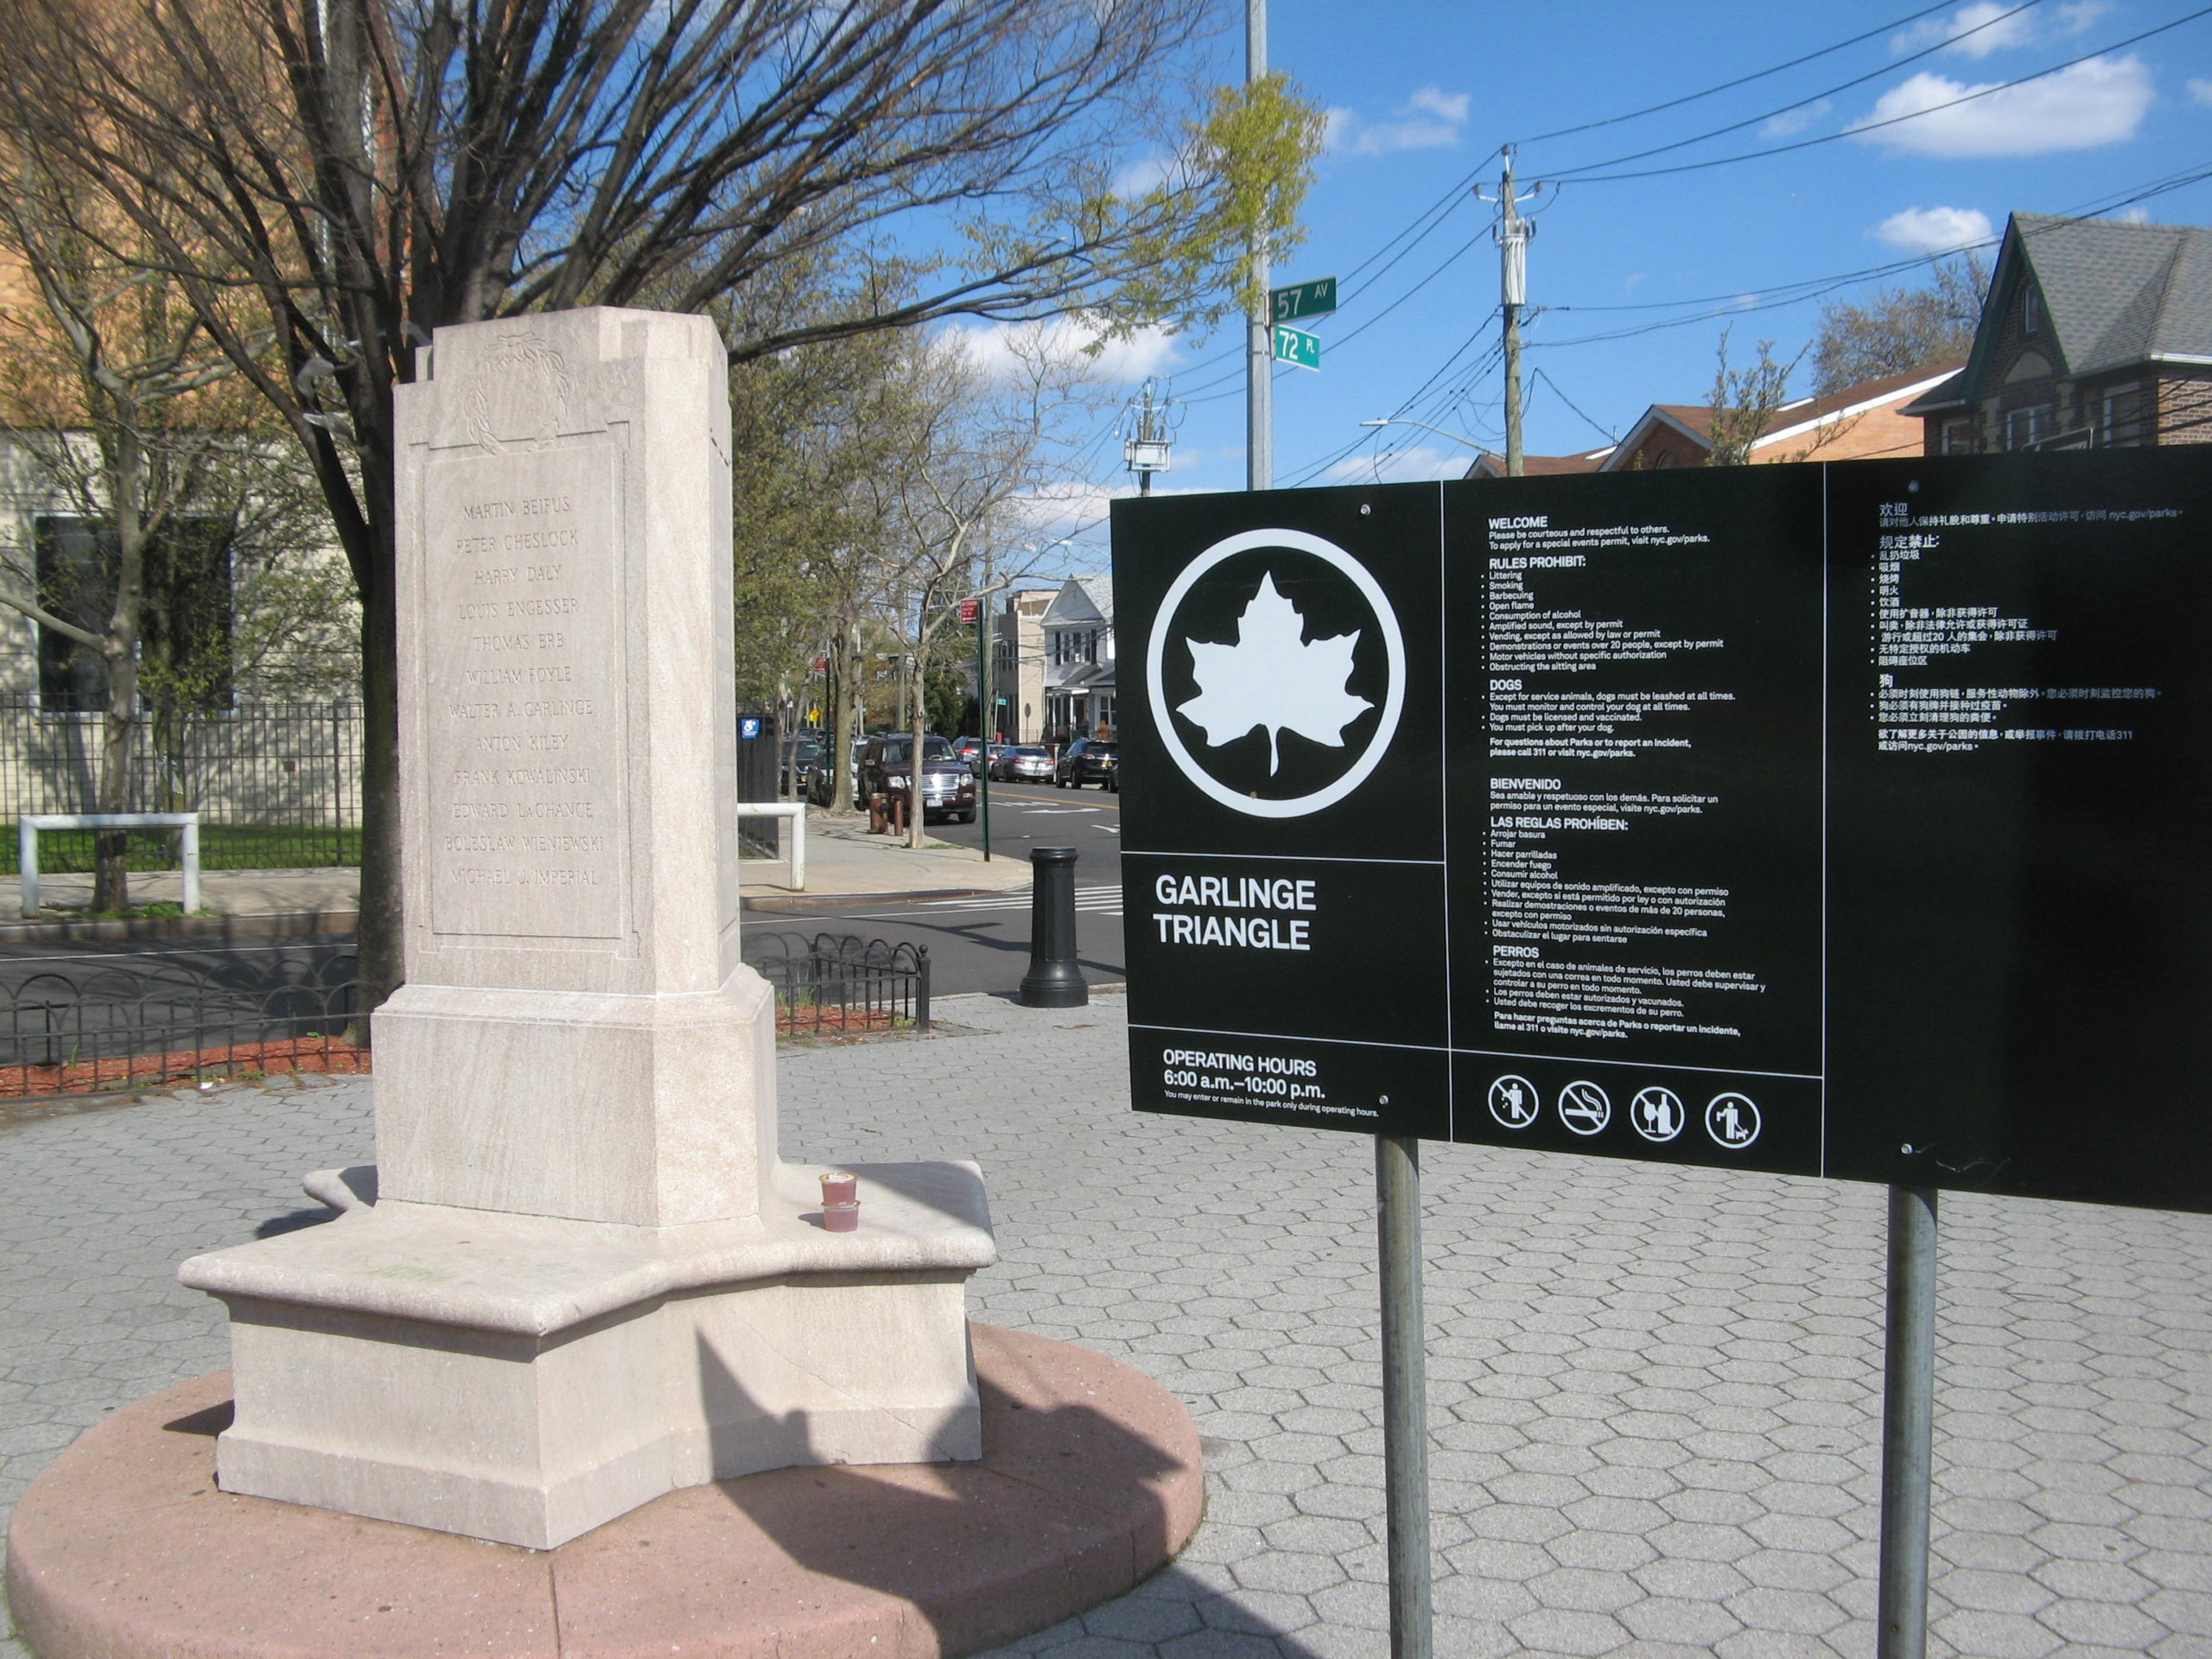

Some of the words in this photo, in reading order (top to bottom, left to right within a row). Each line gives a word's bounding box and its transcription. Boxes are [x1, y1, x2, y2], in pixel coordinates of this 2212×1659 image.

[1279, 289, 1302, 318] 57
[1315, 283, 1327, 298] AV
[1280, 330, 1298, 359] 72
[1306, 339, 1314, 353] PL
[463, 501, 514, 520] MARTIN
[522, 496, 570, 516] BEIFUS
[1878, 503, 1908, 517] 欢迎
[1488, 517, 1548, 530] WELCOME
[1488, 531, 1515, 540] Please
[1516, 531, 1527, 539] be
[1528, 529, 1568, 538] courteous
[1569, 528, 1585, 537] and
[1586, 526, 1629, 538] respectful
[1640, 525, 1669, 534] others.
[456, 537, 496, 554] PETER
[503, 529, 579, 551] CHESLOCK
[1489, 541, 1498, 550] To
[1499, 541, 1521, 551] apply
[1522, 540, 1534, 549] for
[1541, 539, 1570, 550] special
[1571, 537, 1599, 547] events
[1600, 537, 1630, 548] permit,
[1630, 536, 1649, 544] visit
[1649, 534, 1710, 546] nyc.gov/parks.
[1489, 556, 1527, 569] RULES
[1529, 555, 1586, 568] PROHIBIT:
[1878, 562, 1900, 572] 吸烟
[474, 567, 518, 586] HARRY
[527, 564, 562, 582] DALY
[1489, 570, 1522, 582] Littering
[1489, 581, 1523, 592] Smoking
[1878, 585, 1899, 596] 明火
[1489, 591, 1534, 602] Barbecuing
[1878, 597, 1899, 607] 饮酒
[459, 602, 498, 620] LOUIS
[508, 598, 579, 617] ENGESSER
[1489, 601, 1510, 612] Open
[1510, 601, 1535, 609] flame
[1489, 611, 1541, 622] Consumption
[1551, 610, 1581, 619] alcohol
[1489, 621, 1526, 632] Amplified
[1528, 620, 1554, 630] sound,
[1555, 620, 1583, 631] except
[1584, 620, 1594, 630] by
[1595, 620, 1623, 630] permit
[474, 634, 530, 652] THOMAS
[539, 632, 564, 649] ERB
[1489, 632, 1522, 642] Vending,
[1523, 631, 1550, 642] except
[1562, 631, 1593, 639] allowed
[1595, 631, 1605, 640] by
[1606, 630, 1621, 639] law
[1633, 629, 1661, 640] permit
[1514, 652, 1546, 660] vehicles
[1547, 652, 1578, 660] without
[1579, 652, 1611, 662] specific
[1612, 651, 1667, 659] authorization
[1490, 662, 1535, 672] Obstructing
[1536, 662, 1550, 671] the
[1551, 662, 1577, 672] sitting
[467, 668, 522, 684] WILLIAM
[529, 667, 572, 683] FOYLE
[1878, 674, 1894, 688] 狗
[1490, 679, 1522, 690] DOGS
[449, 703, 499, 719] WALTER
[524, 700, 593, 717] GARLINGE
[1490, 713, 1509, 722] Dogs
[1526, 723, 1543, 734] pick
[1544, 725, 1555, 734] up
[1577, 725, 1595, 734] your
[1597, 723, 1614, 734] dog.
[475, 735, 520, 752] ANTON
[530, 734, 569, 752] KILEY
[1490, 748, 1516, 758] please
[1576, 748, 1636, 759] nyc.gov/parks.
[454, 769, 499, 785] FRANK
[506, 767, 591, 785] KOWALINSKI
[1490, 779, 1561, 790] BIENVENIDO
[453, 803, 507, 818] EDWARD
[1491, 816, 1513, 828] LAS
[1515, 817, 1561, 829] REGLAS
[1563, 815, 1629, 830] PROHÍBEN:
[1491, 830, 1517, 840] Arrojar
[1518, 830, 1546, 838] basura
[444, 836, 514, 850] BOLESLAW
[1491, 839, 1516, 848] Fumar
[1491, 849, 1514, 858] Hacer
[1515, 850, 1557, 861] parrilladas
[1491, 860, 1528, 868] Encender
[1529, 861, 1552, 871] fuego
[450, 868, 512, 885] MICHAEL
[534, 869, 598, 886] IMPERIAL
[1491, 869, 1528, 879] Consumir
[1529, 870, 1558, 880] alcohol
[1156, 874, 1316, 911] GARLINGE
[1153, 913, 1310, 950] TRIANGLE
[1492, 945, 1540, 958] PERROS
[1163, 1049, 1253, 1071] OPERATING
[1258, 1057, 1317, 1077] HOURS
[1165, 1070, 1197, 1087] 6:00
[1290, 1084, 1325, 1099] p.m.
[1220, 1096, 1244, 1104] remain
[1265, 1099, 1281, 1109] park
[1282, 1101, 1297, 1110] only
[1298, 1103, 1320, 1113] during
[1321, 1104, 1356, 1116] operating
[1356, 1108, 1379, 1116] hours.
